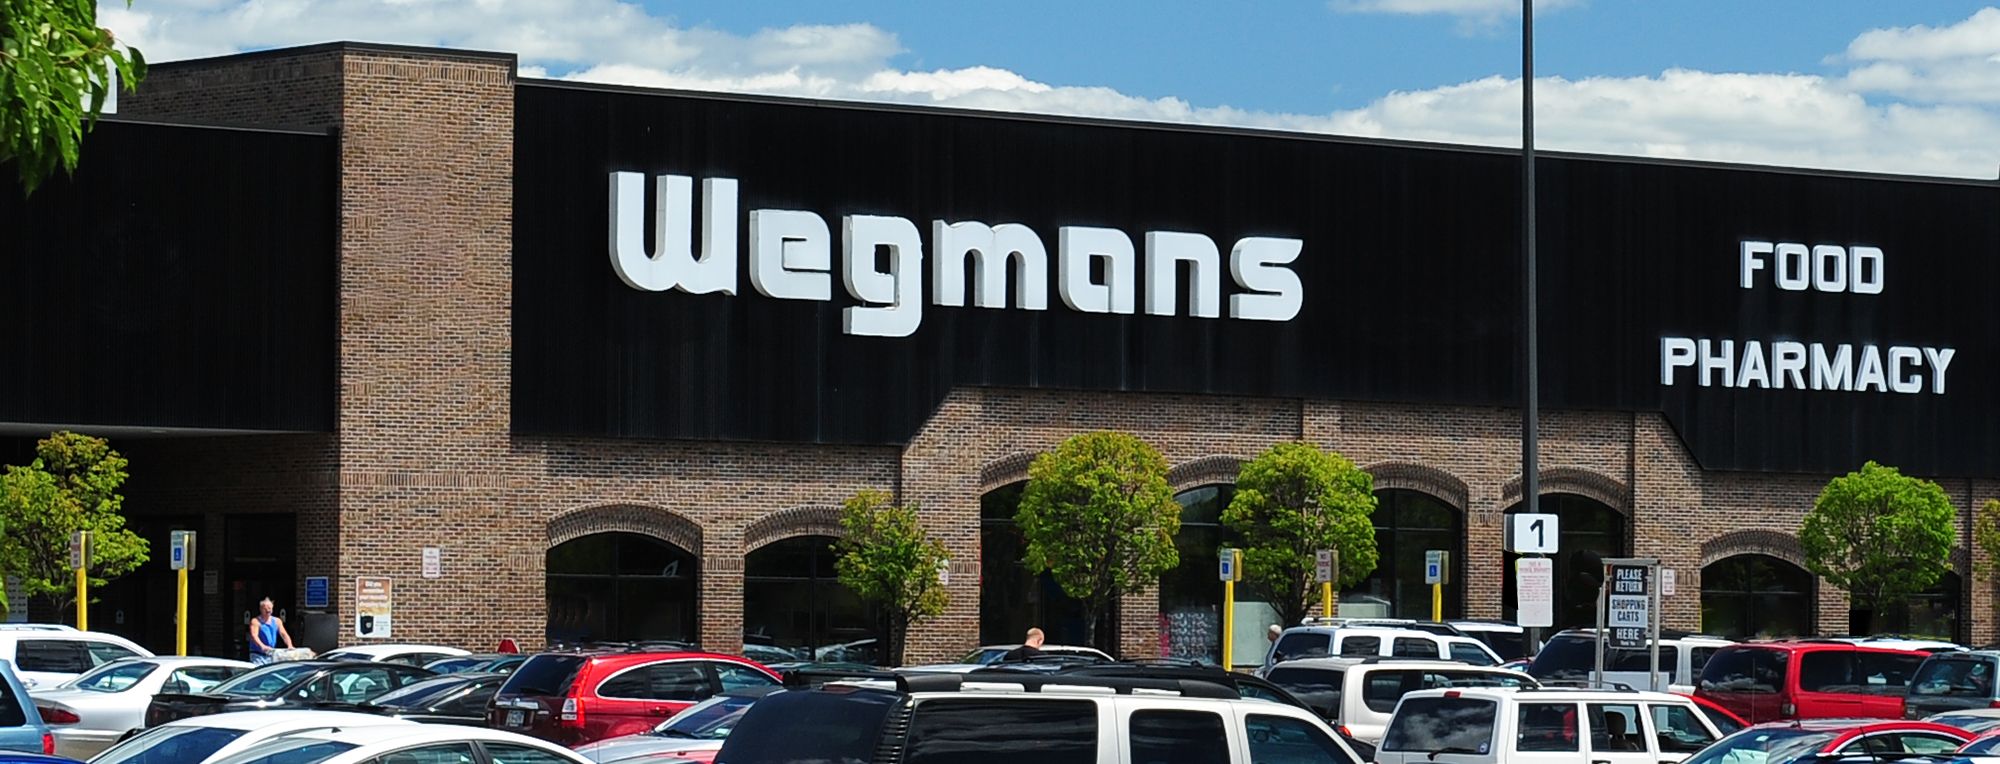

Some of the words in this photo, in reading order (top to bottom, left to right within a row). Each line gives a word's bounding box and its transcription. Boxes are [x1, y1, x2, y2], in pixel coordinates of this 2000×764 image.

[609, 171, 1303, 337] Wegmans
[1740, 240, 1884, 295] FOOD
[1660, 336, 1956, 395] PHARMACY
[1530, 519, 1544, 548] 1
[1616, 568, 1643, 580] PLEASE
[1615, 580, 1643, 593] RETURN
[1611, 598, 1646, 611] SHOPPING
[1616, 610, 1640, 622] CARTS
[1616, 628, 1640, 640] HERE
